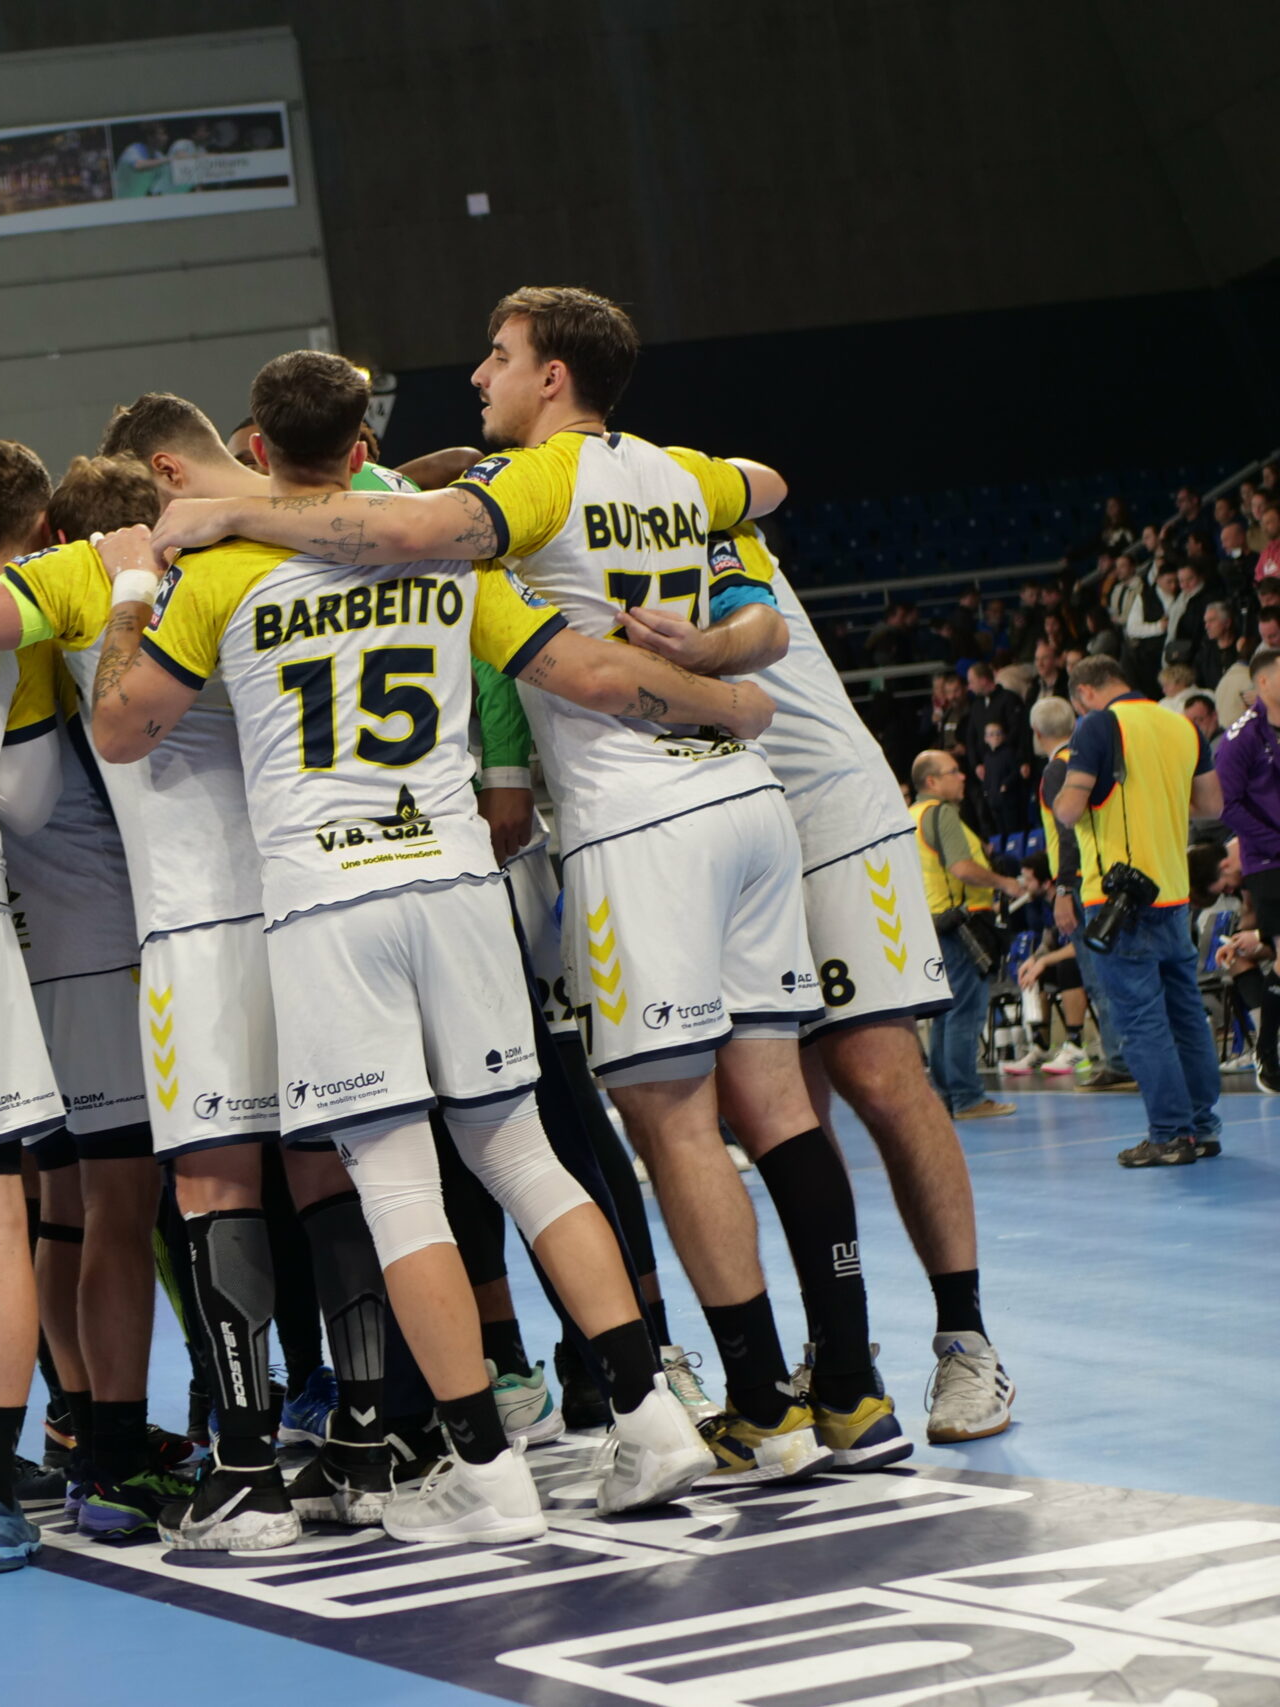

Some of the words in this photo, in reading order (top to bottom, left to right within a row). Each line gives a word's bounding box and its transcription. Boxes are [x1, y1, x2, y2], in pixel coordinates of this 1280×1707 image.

[584, 502, 706, 550] BUTRAC
[256, 577, 464, 652] BARBEITO
[278, 646, 440, 772] 15
[316, 827, 373, 853] V.B.
[341, 861, 361, 870] Une
[395, 848, 442, 860] HomeServe
[677, 996, 722, 1019] transd
[312, 1070, 386, 1099] transdev
[73, 1092, 105, 1106] ADIM
[227, 1093, 280, 1112] transd
[317, 1101, 328, 1109] the
[330, 1094, 357, 1107] mobility
[357, 1087, 389, 1103] company
[220, 1321, 248, 1408] BOOSTER
